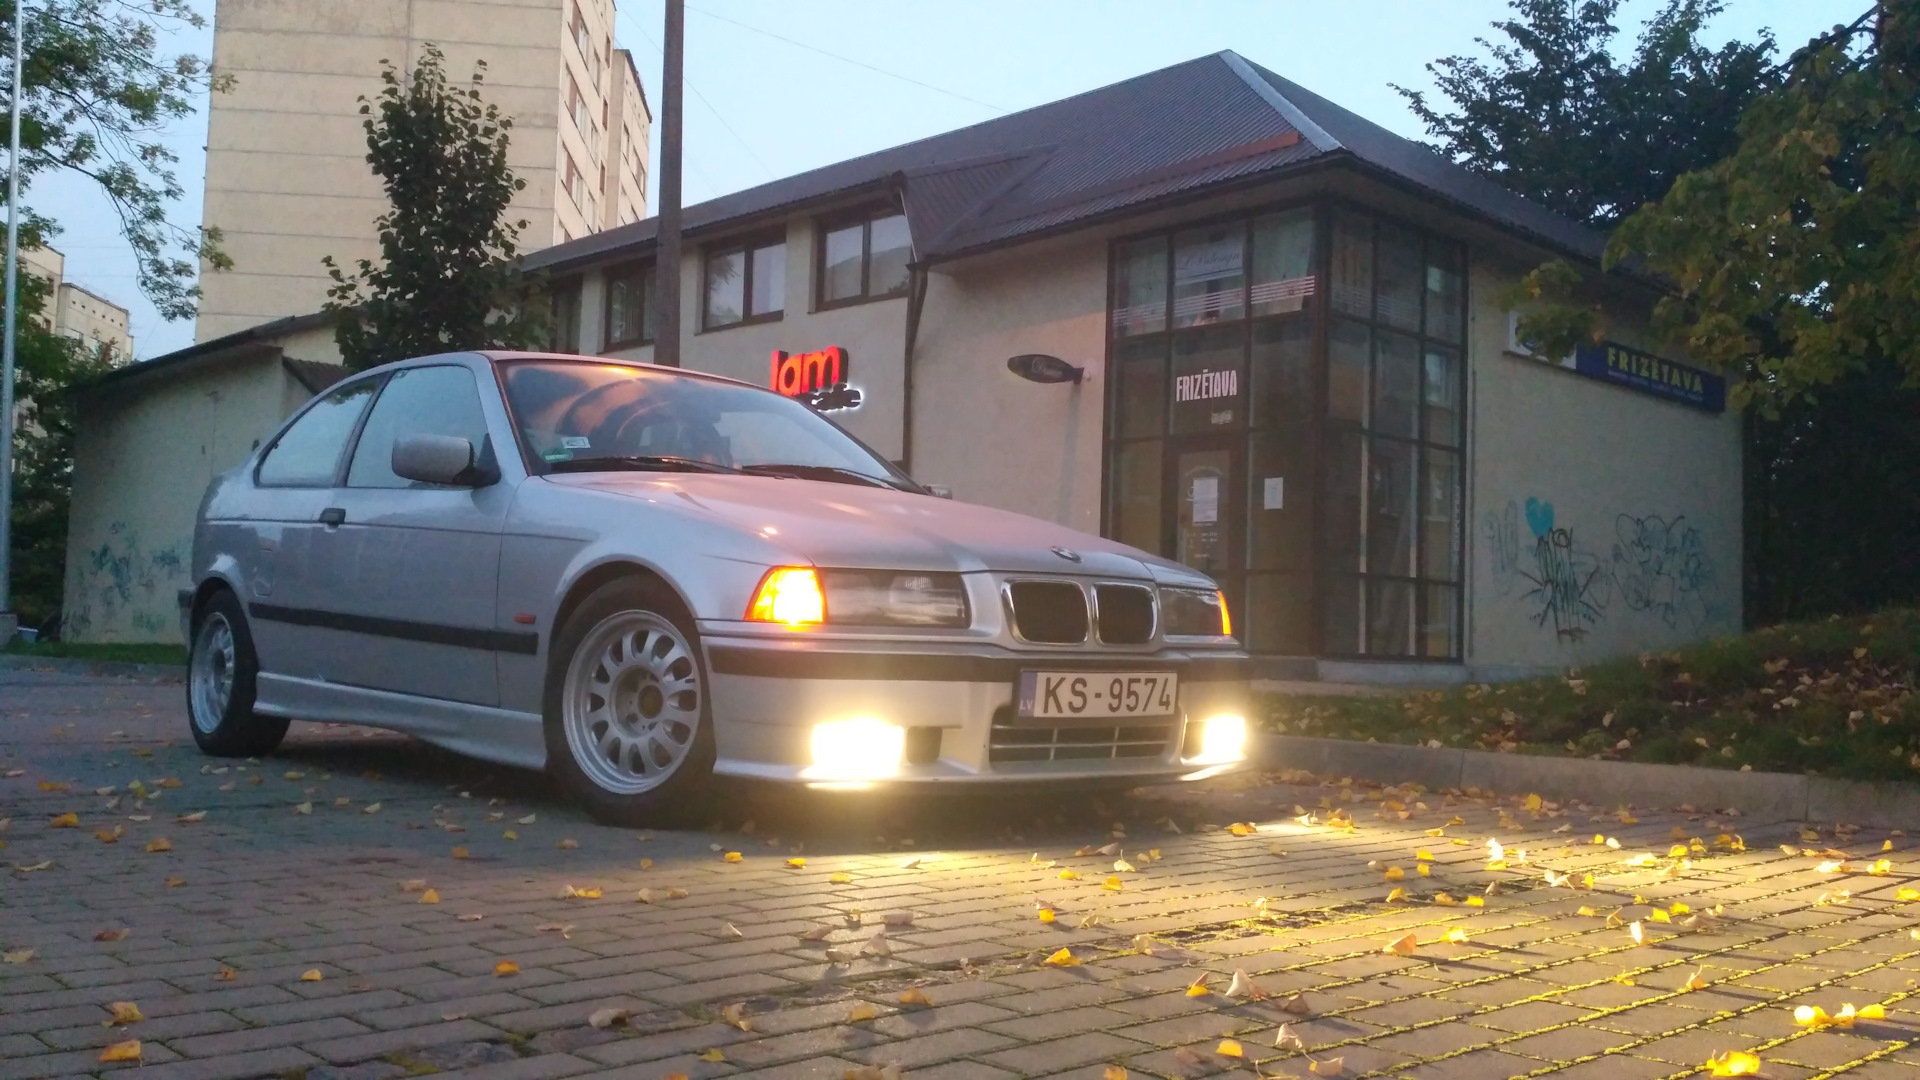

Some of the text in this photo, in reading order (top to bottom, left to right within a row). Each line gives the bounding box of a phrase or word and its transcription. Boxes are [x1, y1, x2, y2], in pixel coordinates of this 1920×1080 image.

[1176, 368, 1238, 402] FRIZĒTAVA
[1019, 700, 1033, 711] LV
[1043, 677, 1171, 714] KS-9574
